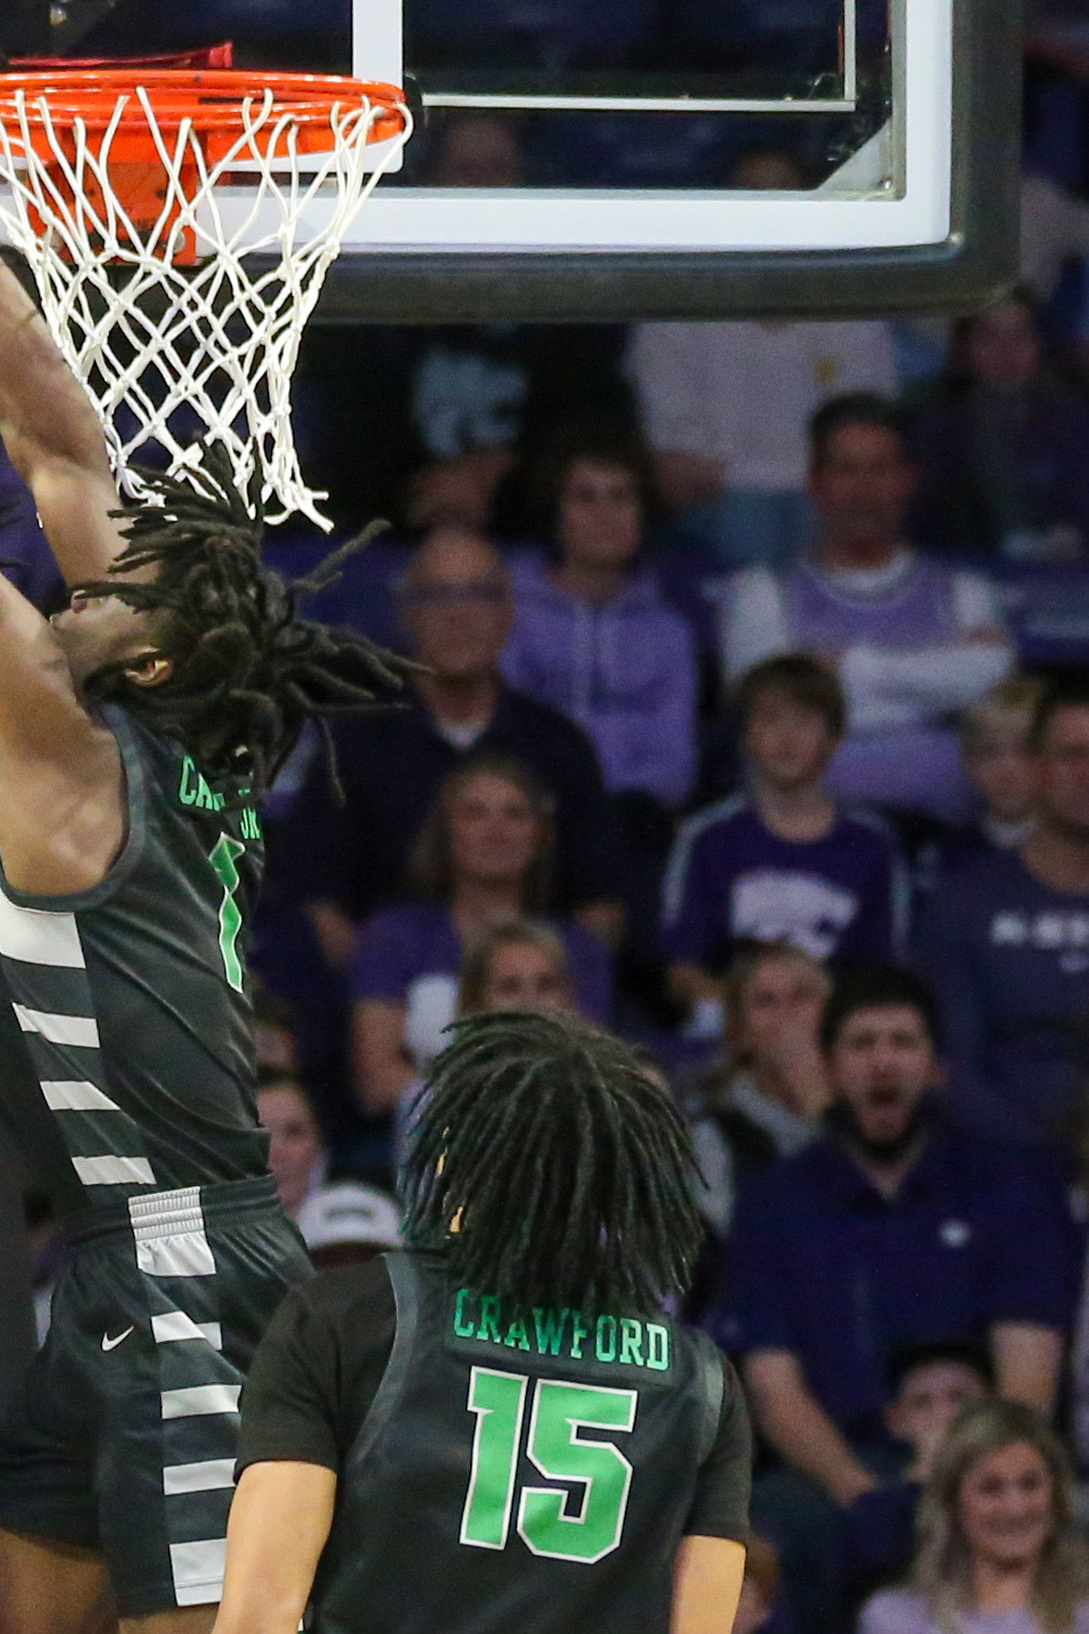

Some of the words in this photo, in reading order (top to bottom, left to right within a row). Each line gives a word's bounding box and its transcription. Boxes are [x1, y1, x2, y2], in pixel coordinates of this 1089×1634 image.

[208, 831, 246, 993] 1
[453, 1288, 669, 1372] CRAWFORD
[459, 1365, 638, 1564] 15
